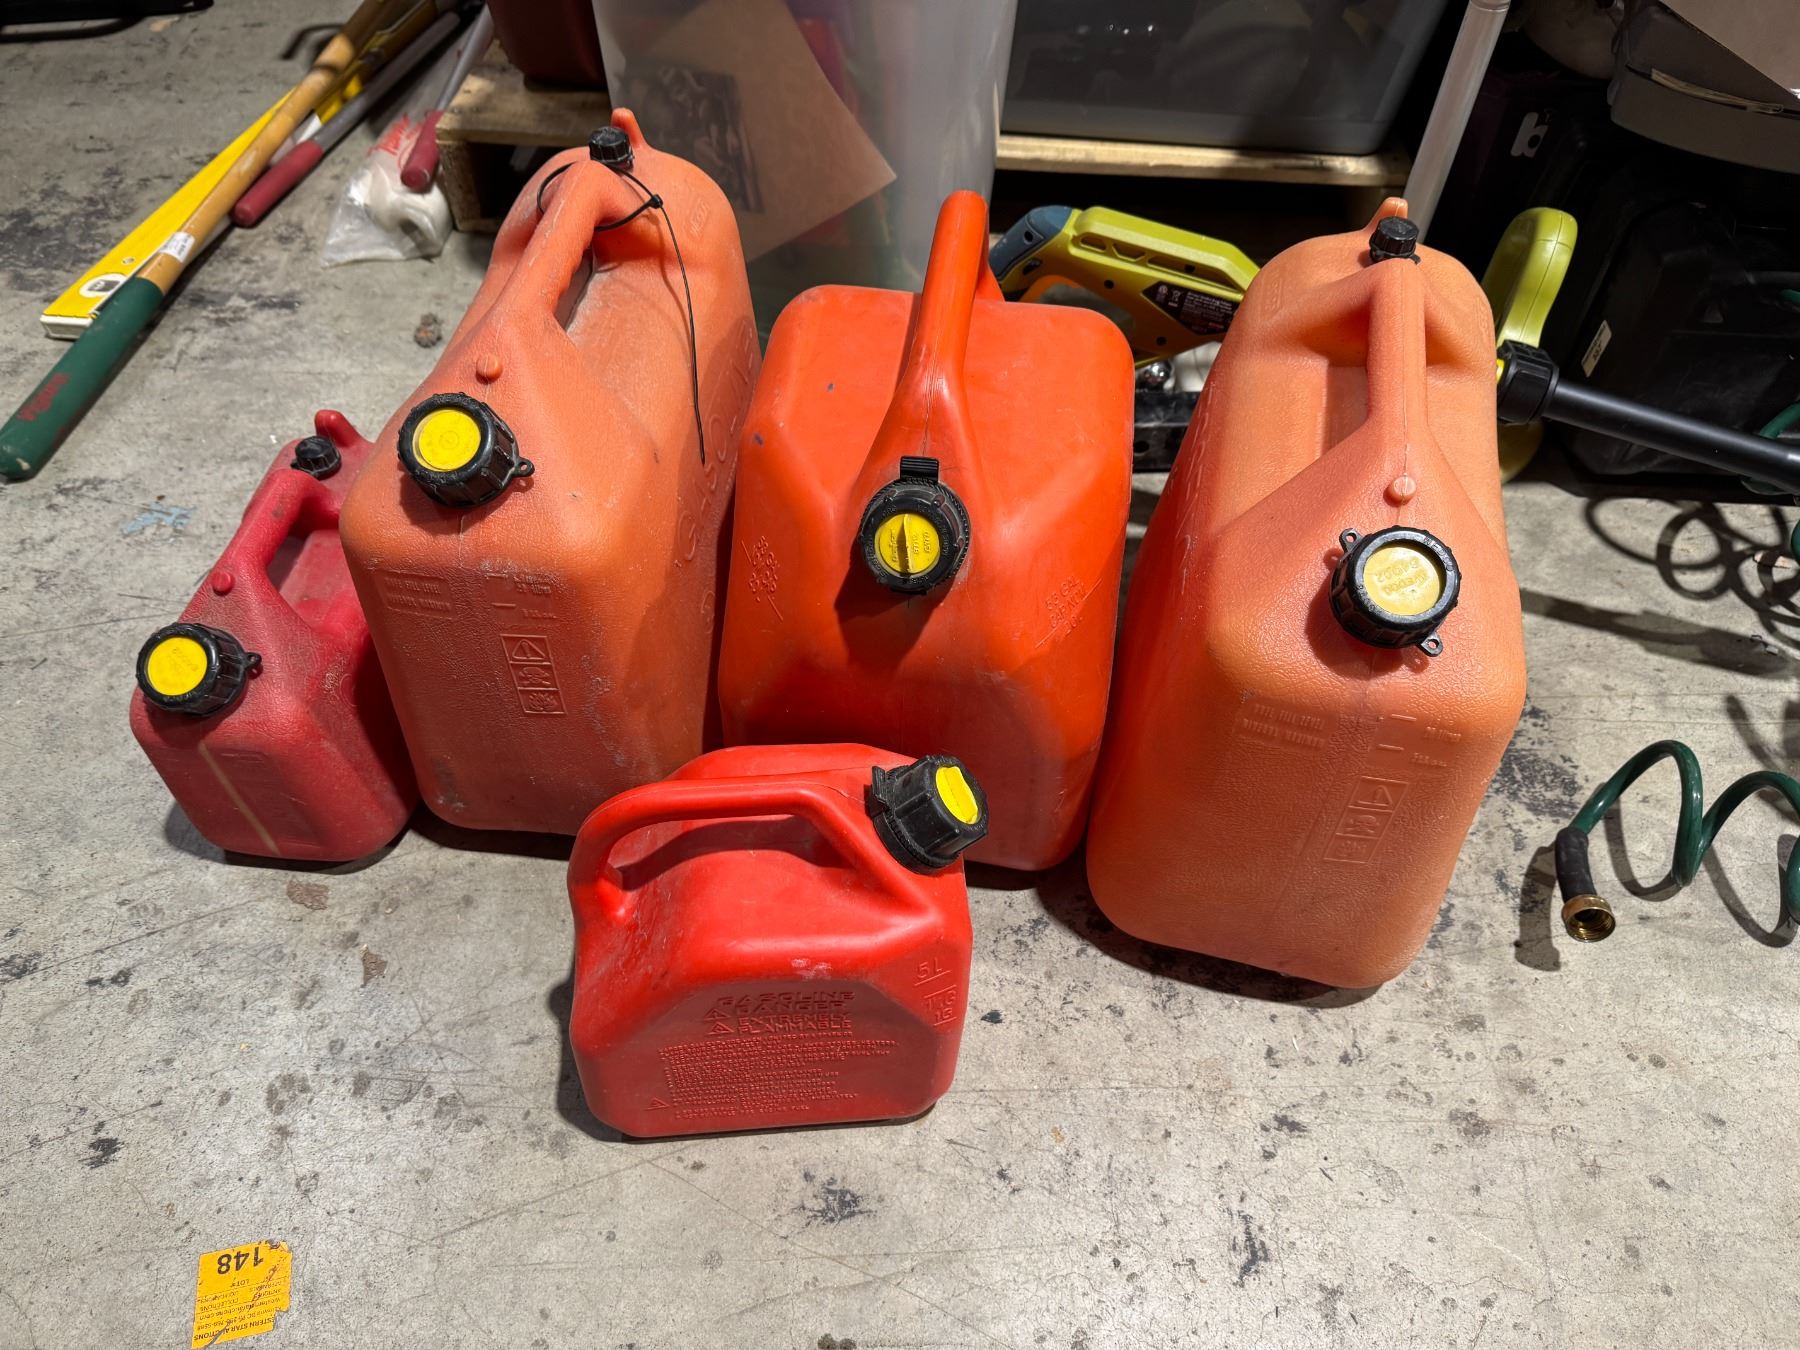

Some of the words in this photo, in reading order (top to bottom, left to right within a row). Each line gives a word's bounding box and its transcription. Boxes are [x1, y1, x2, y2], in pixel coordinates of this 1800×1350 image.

[717, 991, 855, 1007] GASOLINE
[735, 1000, 847, 1014] DANGER
[738, 1012, 850, 1026] EXTREMELY
[738, 1020, 852, 1034] FLAMMABLE
[217, 1247, 263, 1275] 148
[231, 1323, 248, 1333] STAR
[250, 1316, 275, 1328] ESTERN
[194, 1327, 230, 1341] ACTIONS
